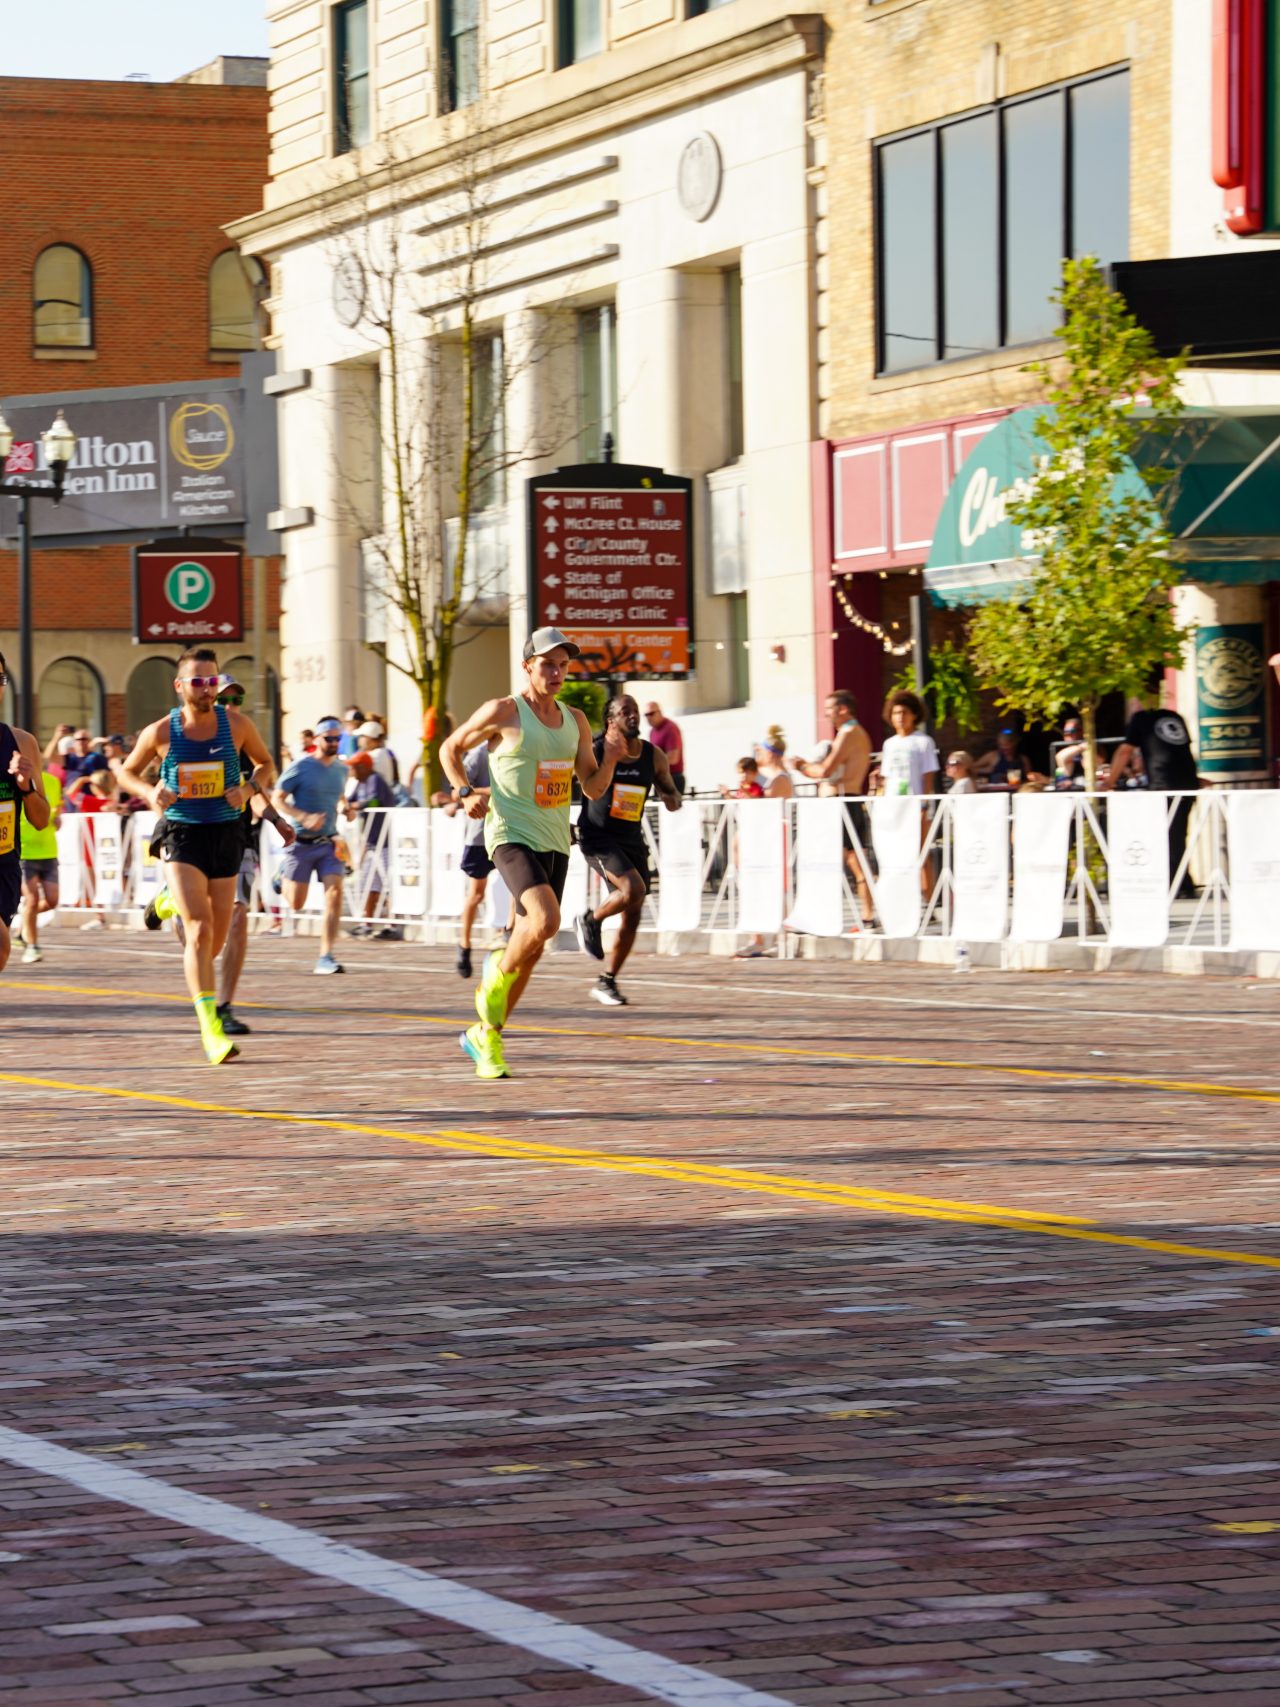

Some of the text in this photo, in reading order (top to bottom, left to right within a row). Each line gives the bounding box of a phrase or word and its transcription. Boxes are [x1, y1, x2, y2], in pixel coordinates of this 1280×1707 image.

[187, 429, 226, 443] Sauce
[35, 436, 157, 472] lton
[106, 470, 157, 492] Inn
[181, 474, 225, 487] Italian
[172, 489, 234, 501] American
[564, 497, 623, 509] UM Flint
[179, 504, 229, 516] Kitchen
[564, 518, 615, 530] McCree
[638, 518, 682, 530] House
[564, 553, 651, 566] Government
[564, 571, 623, 584] State of
[178, 571, 205, 605] P
[564, 587, 675, 602] Michigan Office
[564, 606, 668, 622] Genesys Clinic
[167, 621, 215, 635] Public
[628, 634, 672, 646] Center
[191, 783, 216, 795] 6137
